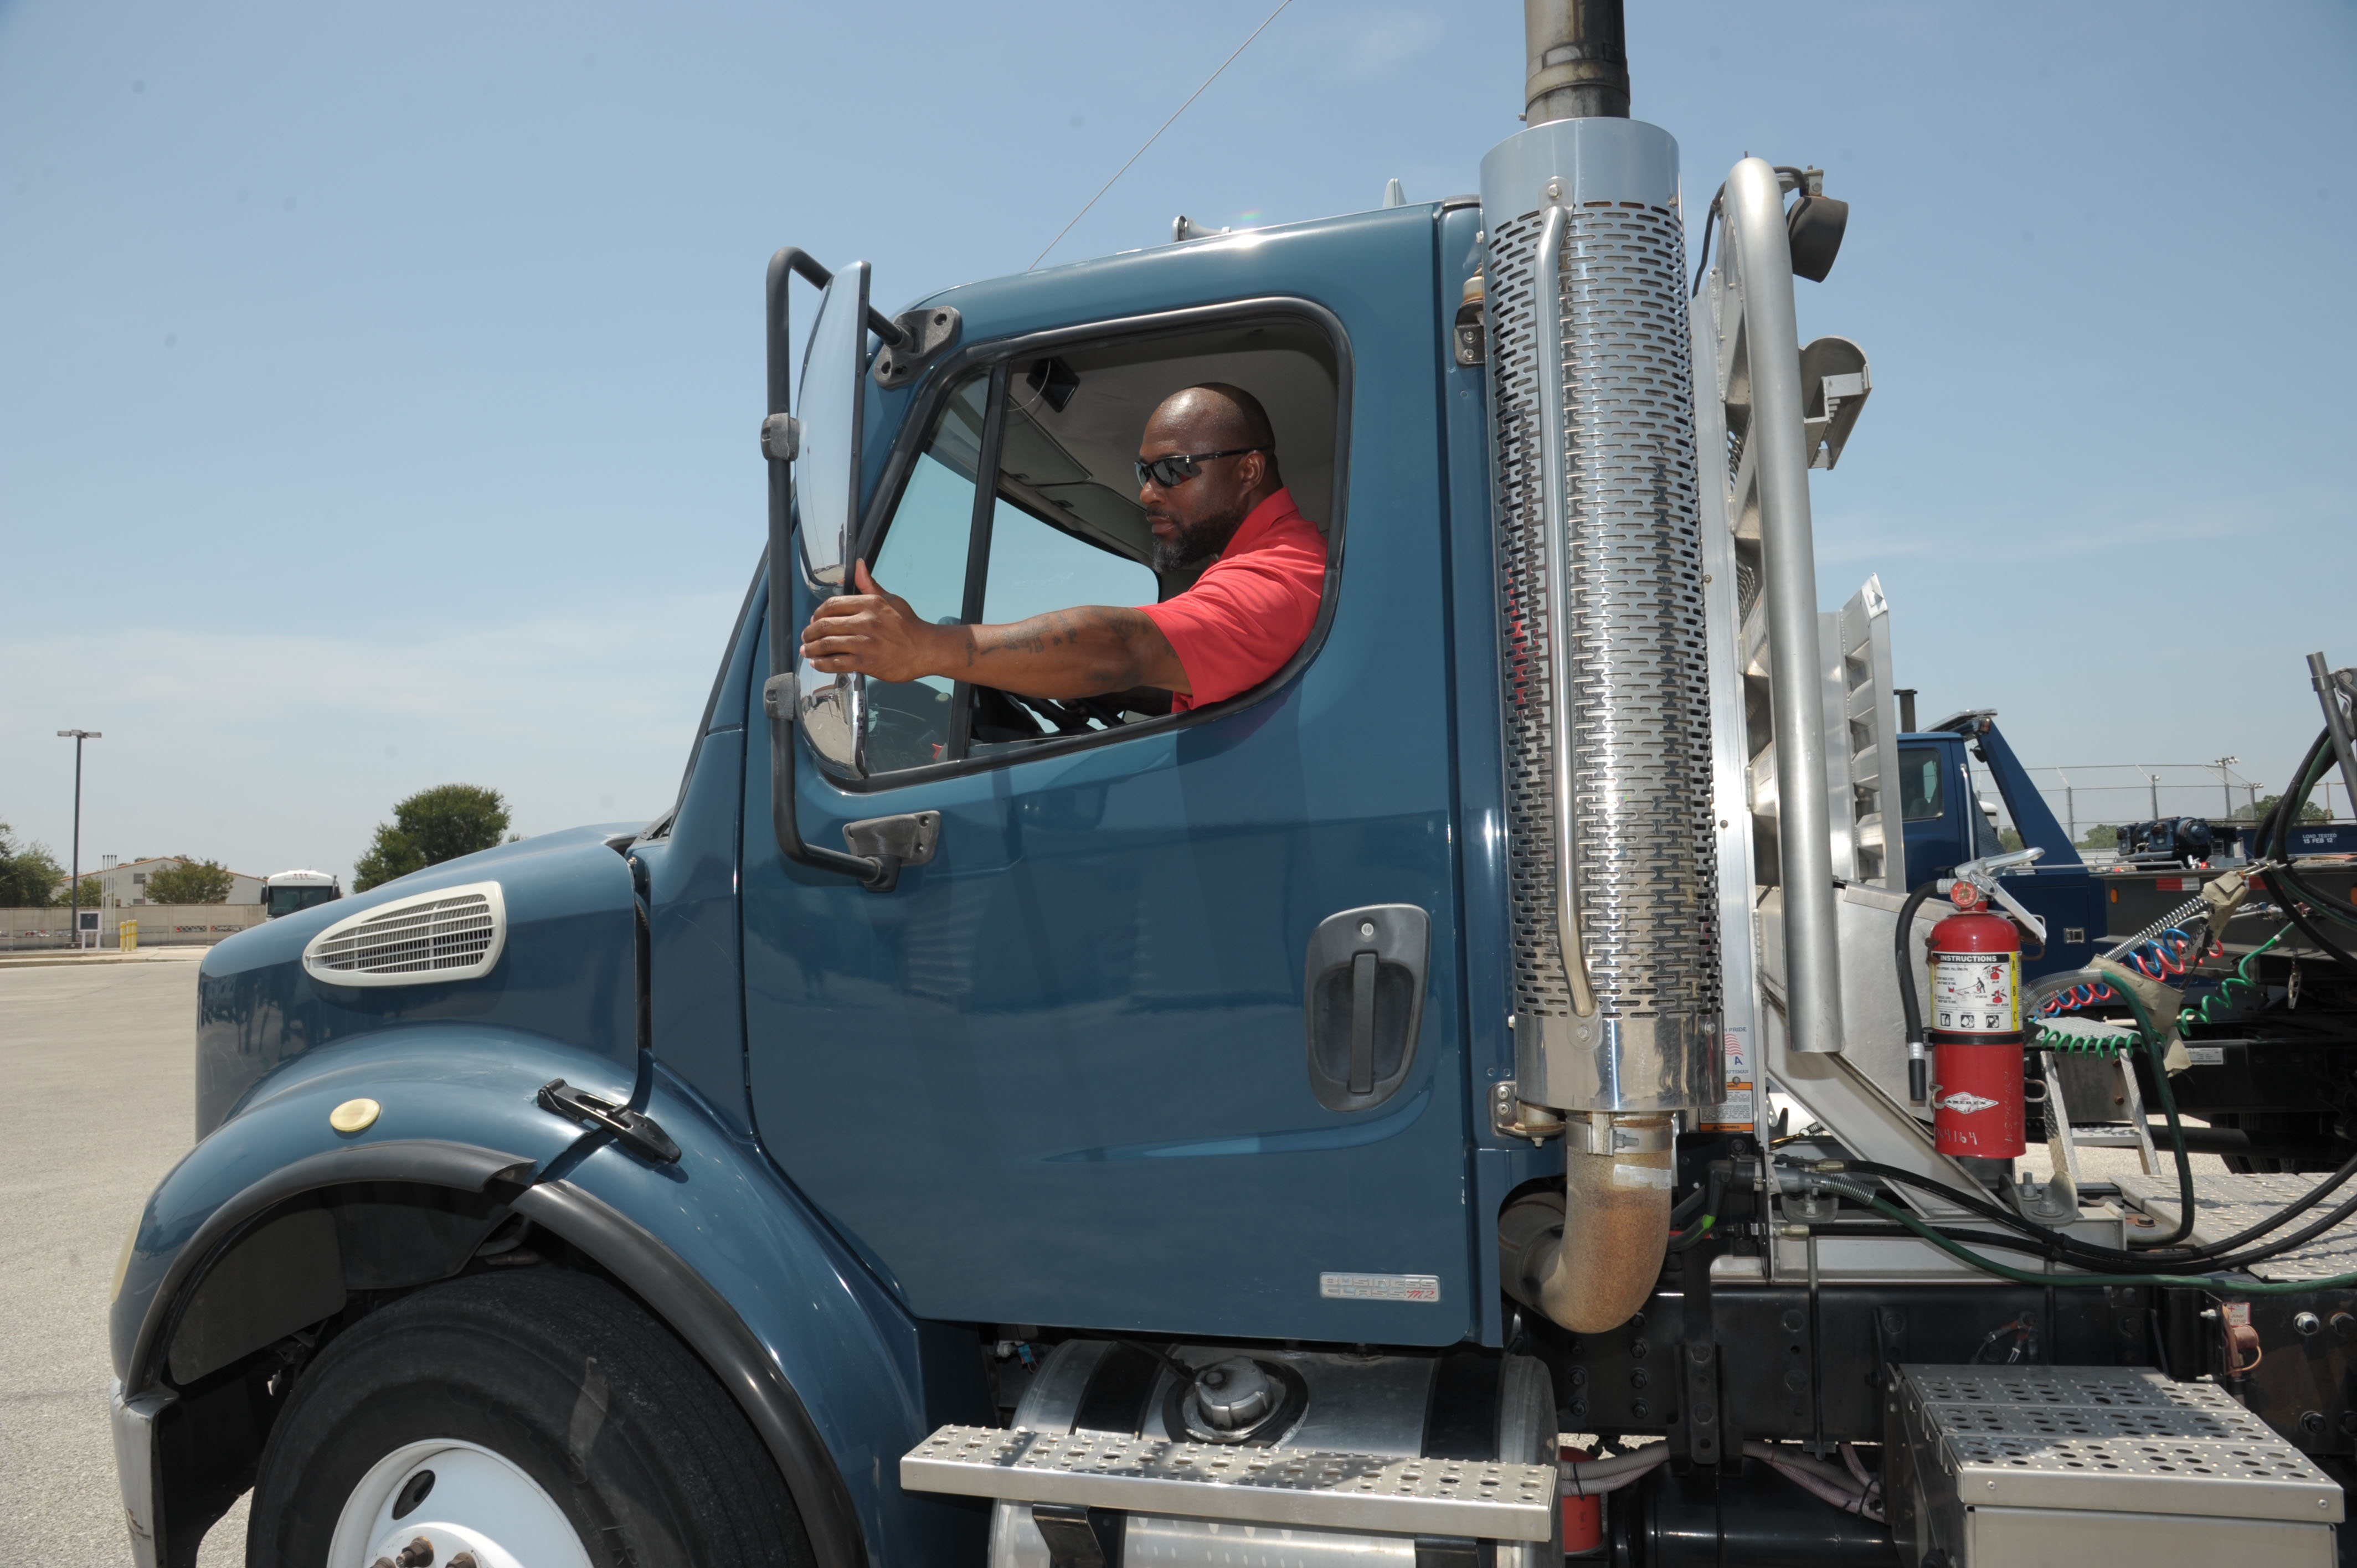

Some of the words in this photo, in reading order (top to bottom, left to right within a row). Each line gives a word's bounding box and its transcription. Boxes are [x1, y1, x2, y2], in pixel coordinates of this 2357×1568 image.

[2011, 960, 2016, 971] A
[2012, 986, 2016, 997] B
[2013, 1010, 2017, 1022] C
[1735, 1056, 1743, 1065] A
[1321, 1275, 1436, 1289] BUSINESS
[1322, 1287, 1405, 1298] CLASS
